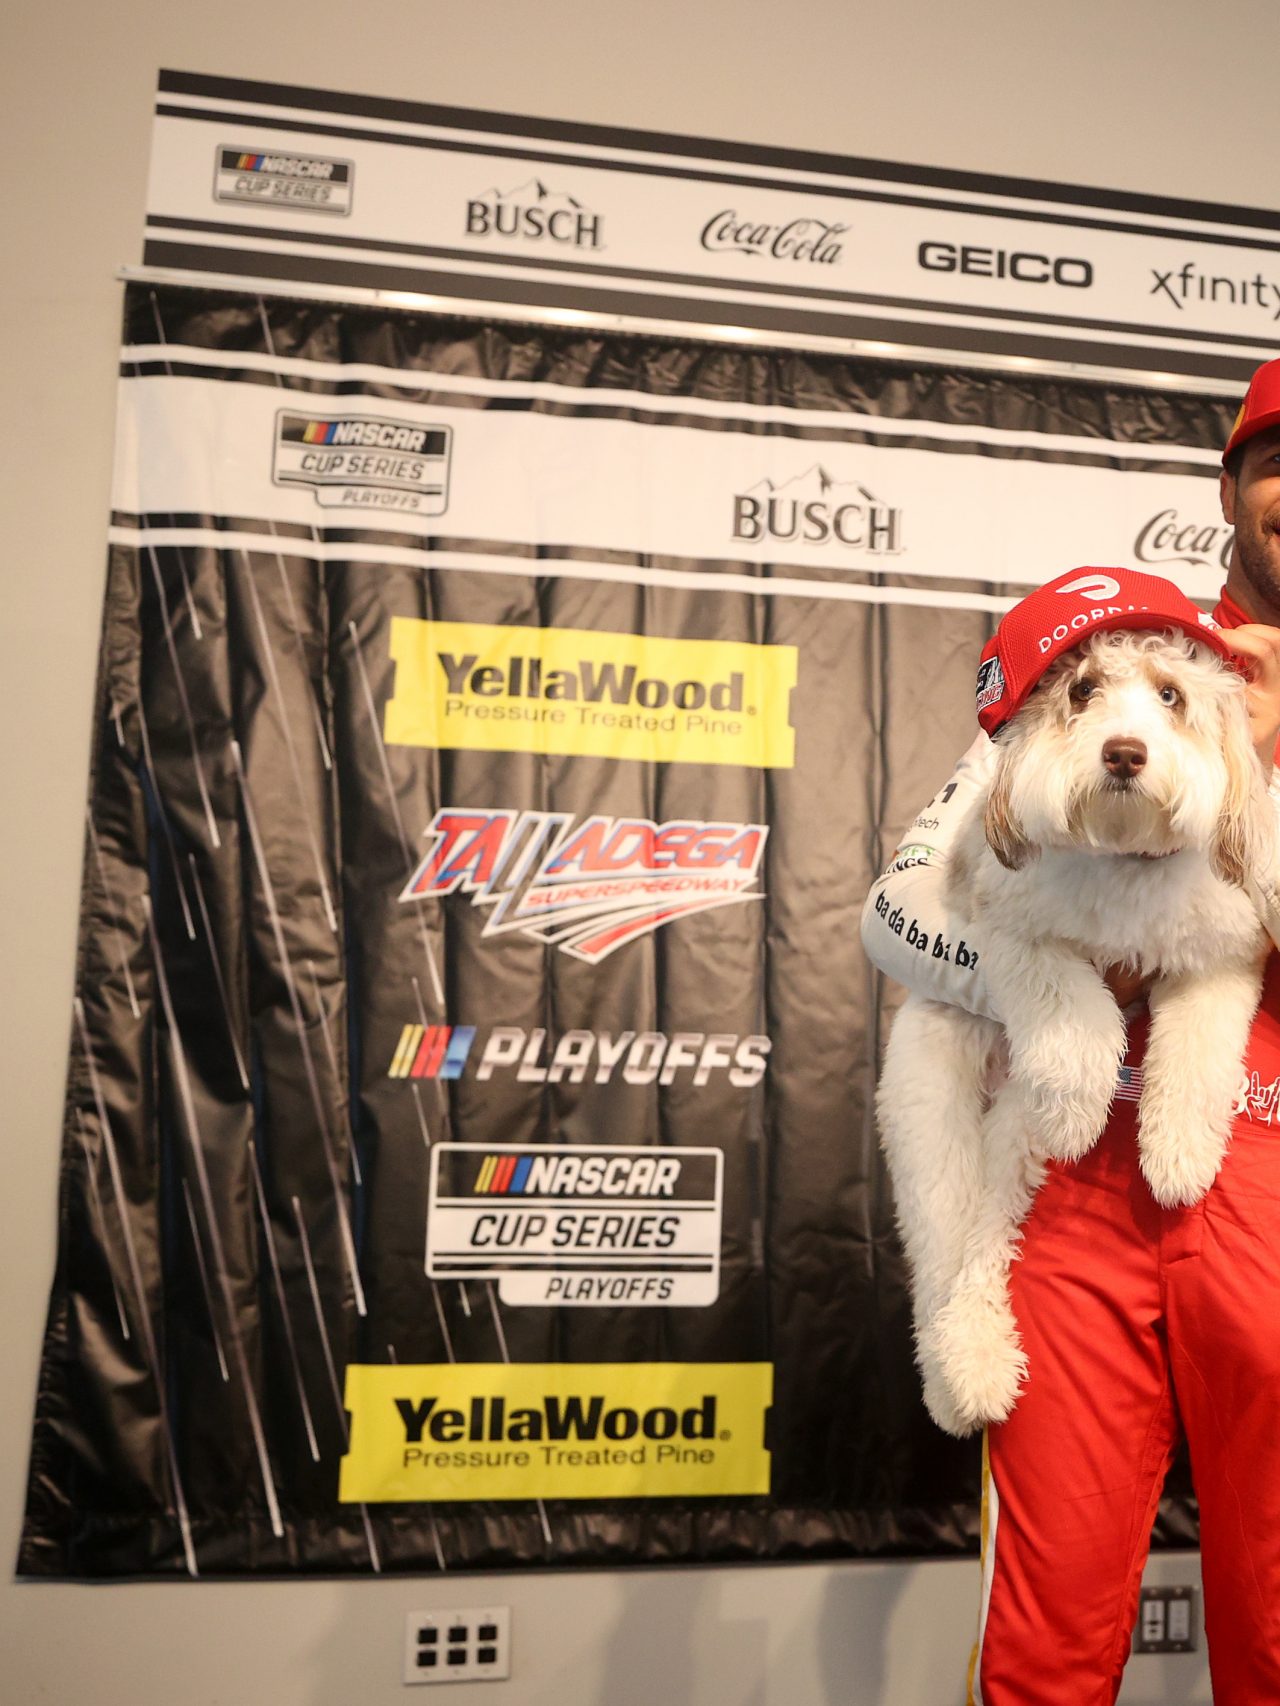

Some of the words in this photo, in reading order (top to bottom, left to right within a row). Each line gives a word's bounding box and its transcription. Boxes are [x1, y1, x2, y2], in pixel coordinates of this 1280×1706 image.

[465, 200, 603, 248] BUSCH
[918, 241, 1093, 288] GEICO
[333, 422, 427, 452] NASCAR
[300, 453, 344, 473] CUP
[347, 454, 425, 480] SERIES
[731, 494, 903, 555] BUSCH
[1133, 508, 1235, 570] Coca-
[445, 700, 566, 724] Pressure
[576, 706, 676, 732] Treated
[686, 715, 742, 736] Pine
[402, 809, 769, 925] TALLADEGA
[527, 877, 750, 908] SUPERSPEEDWAY
[875, 889, 890, 920] ba
[888, 907, 905, 936] da
[906, 919, 929, 952] ba
[476, 1026, 771, 1086] PLAYOFFS
[525, 1156, 682, 1196] NASCAR
[470, 1214, 547, 1248] CUP
[551, 1215, 681, 1249] SERIES
[545, 1278, 675, 1300] PLAYOFFS
[403, 1448, 530, 1469] Pressure
[540, 1445, 646, 1467] Treated
[656, 1444, 716, 1465] Pine
